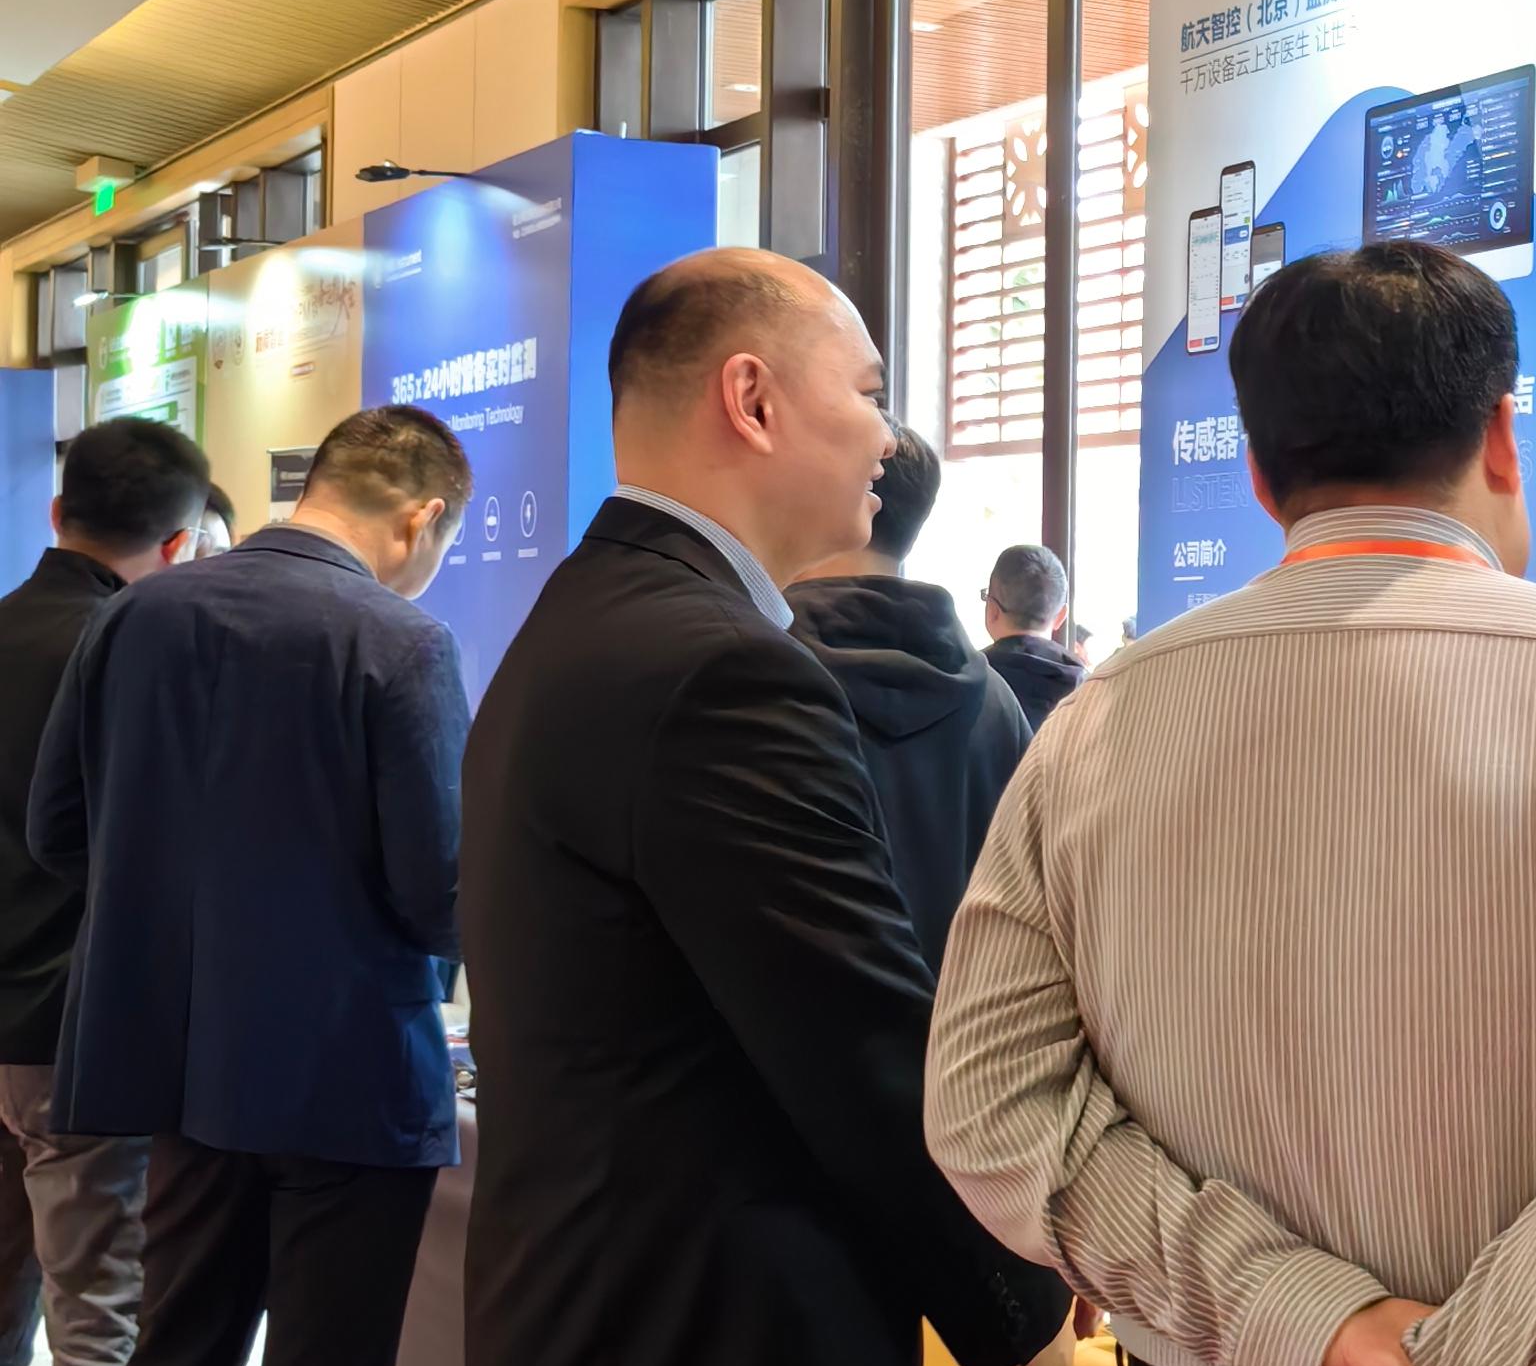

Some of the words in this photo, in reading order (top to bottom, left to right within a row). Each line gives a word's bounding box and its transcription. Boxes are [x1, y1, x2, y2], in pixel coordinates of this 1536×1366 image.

[1180, 30, 1310, 95] 千万设备云上好医生
[1173, 538, 1227, 568] 公司简介
